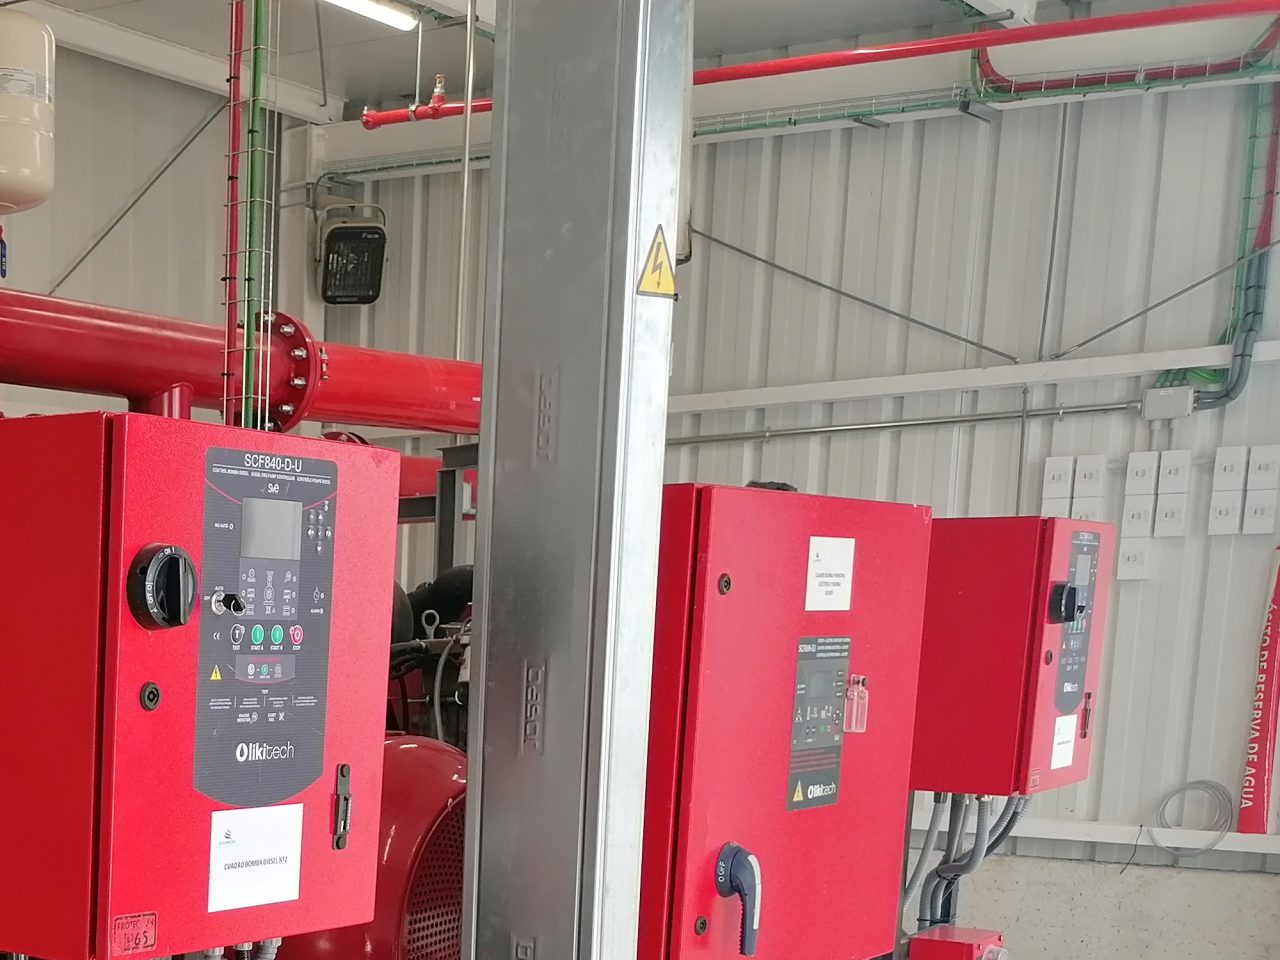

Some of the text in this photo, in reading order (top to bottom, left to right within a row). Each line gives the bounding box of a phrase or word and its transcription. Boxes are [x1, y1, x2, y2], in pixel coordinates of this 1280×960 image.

[244, 453, 302, 472] SCF840-D-U
[1247, 743, 1259, 762] DE
[1240, 766, 1257, 808] AGUA
[223, 861, 245, 871] CUADRO
[245, 859, 263, 868] BOMBA
[262, 857, 279, 866] DIESEL
